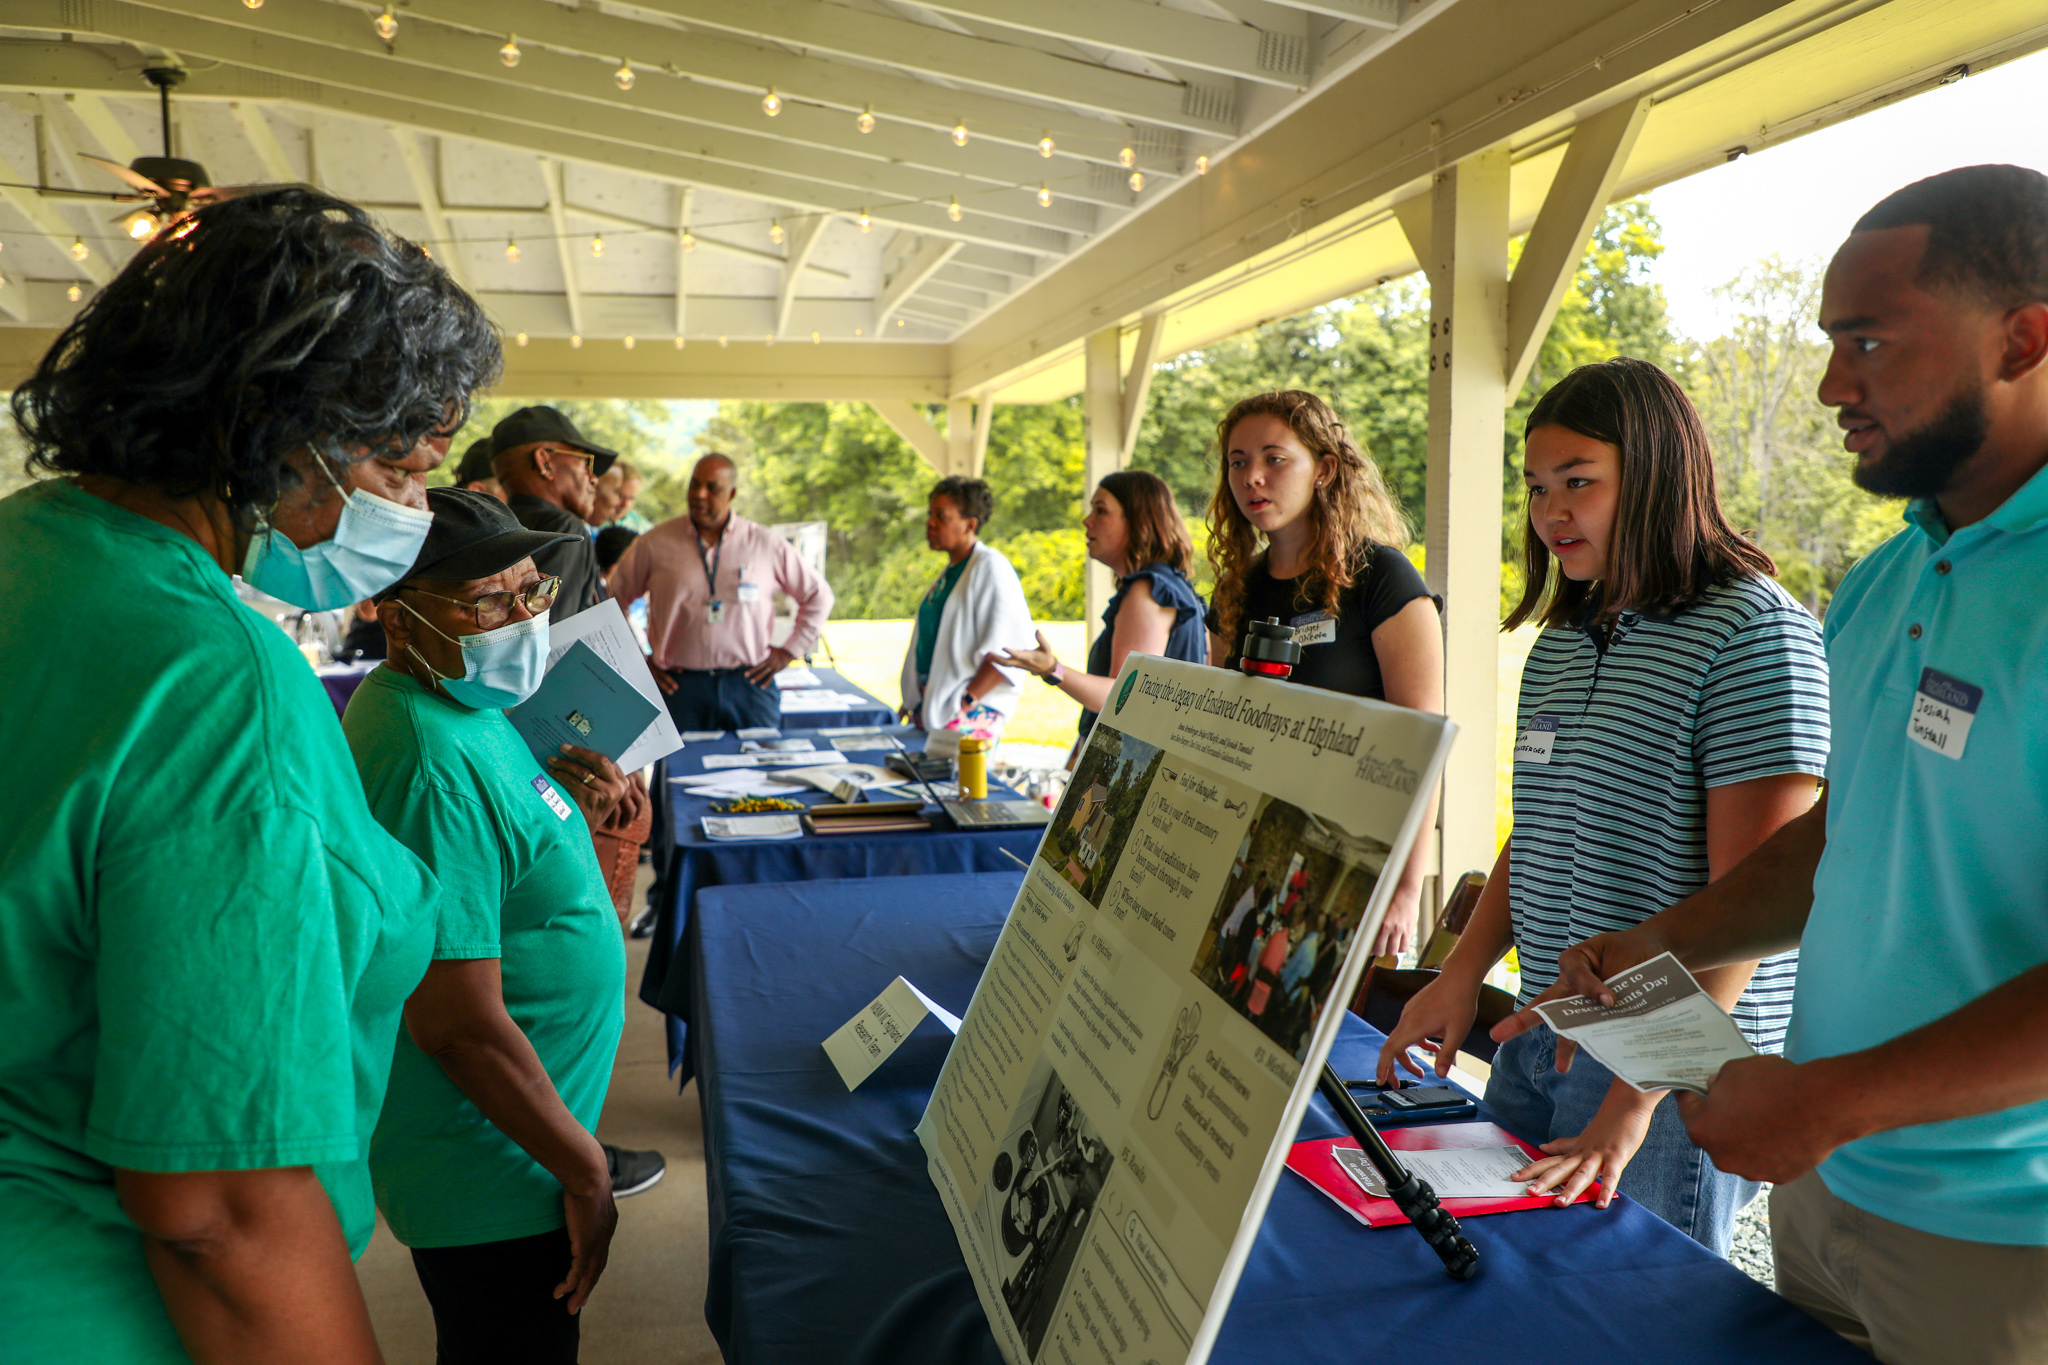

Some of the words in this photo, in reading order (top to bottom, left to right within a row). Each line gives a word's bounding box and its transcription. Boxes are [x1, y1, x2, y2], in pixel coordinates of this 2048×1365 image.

[1139, 673, 1161, 704] Tracing
[1160, 679, 1175, 701] the
[1172, 682, 1197, 714] Legacy
[1195, 688, 1210, 710] of
[1202, 690, 1242, 720] Enslaved
[1237, 697, 1291, 742] Foodways
[1917, 698, 1950, 725] Josiah
[1289, 718, 1306, 740] at
[1303, 716, 1365, 757] Highland
[1913, 717, 1947, 750] Tunstall
[1151, 814, 1163, 829] with
[1158, 796, 1171, 812] What
[1171, 807, 1184, 822] your
[1181, 810, 1196, 829] first
[1194, 820, 1220, 845] memory
[1142, 834, 1156, 851] What
[1159, 846, 1188, 878] traditions
[1186, 863, 1200, 883] have
[1129, 866, 1146, 889] family?
[1135, 850, 1148, 867] been
[1157, 866, 1181, 893] through
[1176, 882, 1194, 901] your
[1113, 903, 1128, 921] from?
[1120, 886, 1135, 904] Where
[1137, 903, 1153, 920] your
[1151, 911, 1164, 929] food
[1162, 922, 1177, 942] come
[1562, 988, 1643, 1016] Desceants
[1642, 975, 1669, 993] Day
[1568, 981, 1629, 1007] Weme
[1629, 973, 1643, 984] to
[1609, 998, 1648, 1015] Highland
[853, 1019, 875, 1048] Research
[868, 1038, 881, 1058] Team
[882, 1016, 905, 1043] Highland
[1205, 1049, 1222, 1072] Oral
[1219, 1062, 1251, 1101] interviews
[1187, 1065, 1208, 1098] Cooking
[1206, 1085, 1250, 1138] demonstrations
[1182, 1093, 1211, 1133] Historical
[1208, 1126, 1236, 1161] research
[1127, 1150, 1147, 1184] Results
[1174, 1121, 1205, 1166] Community
[1203, 1156, 1221, 1184] events
[1354, 1167, 1375, 1187] Welcome
